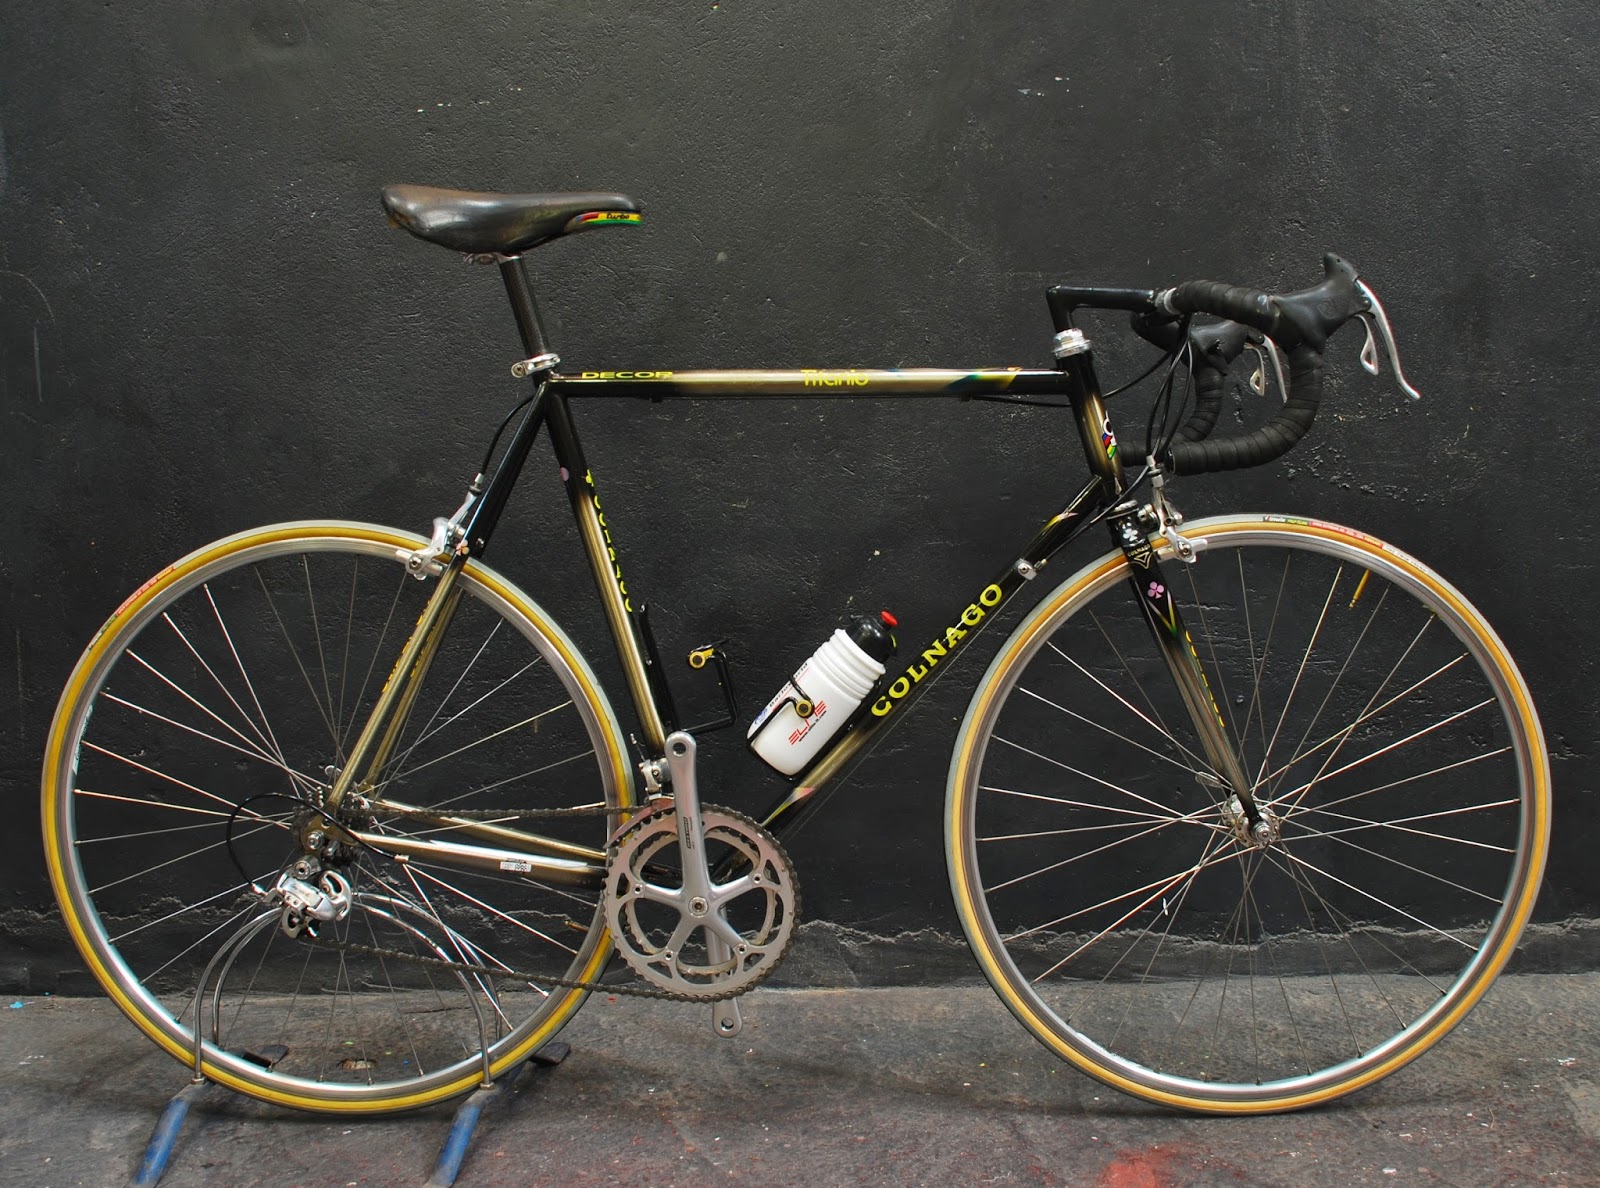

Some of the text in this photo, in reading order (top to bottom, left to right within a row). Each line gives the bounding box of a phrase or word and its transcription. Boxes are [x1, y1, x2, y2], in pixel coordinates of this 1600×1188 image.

[581, 371, 674, 379] DECOR
[800, 369, 869, 386] Titanio
[871, 584, 1003, 717] COLNAGO
